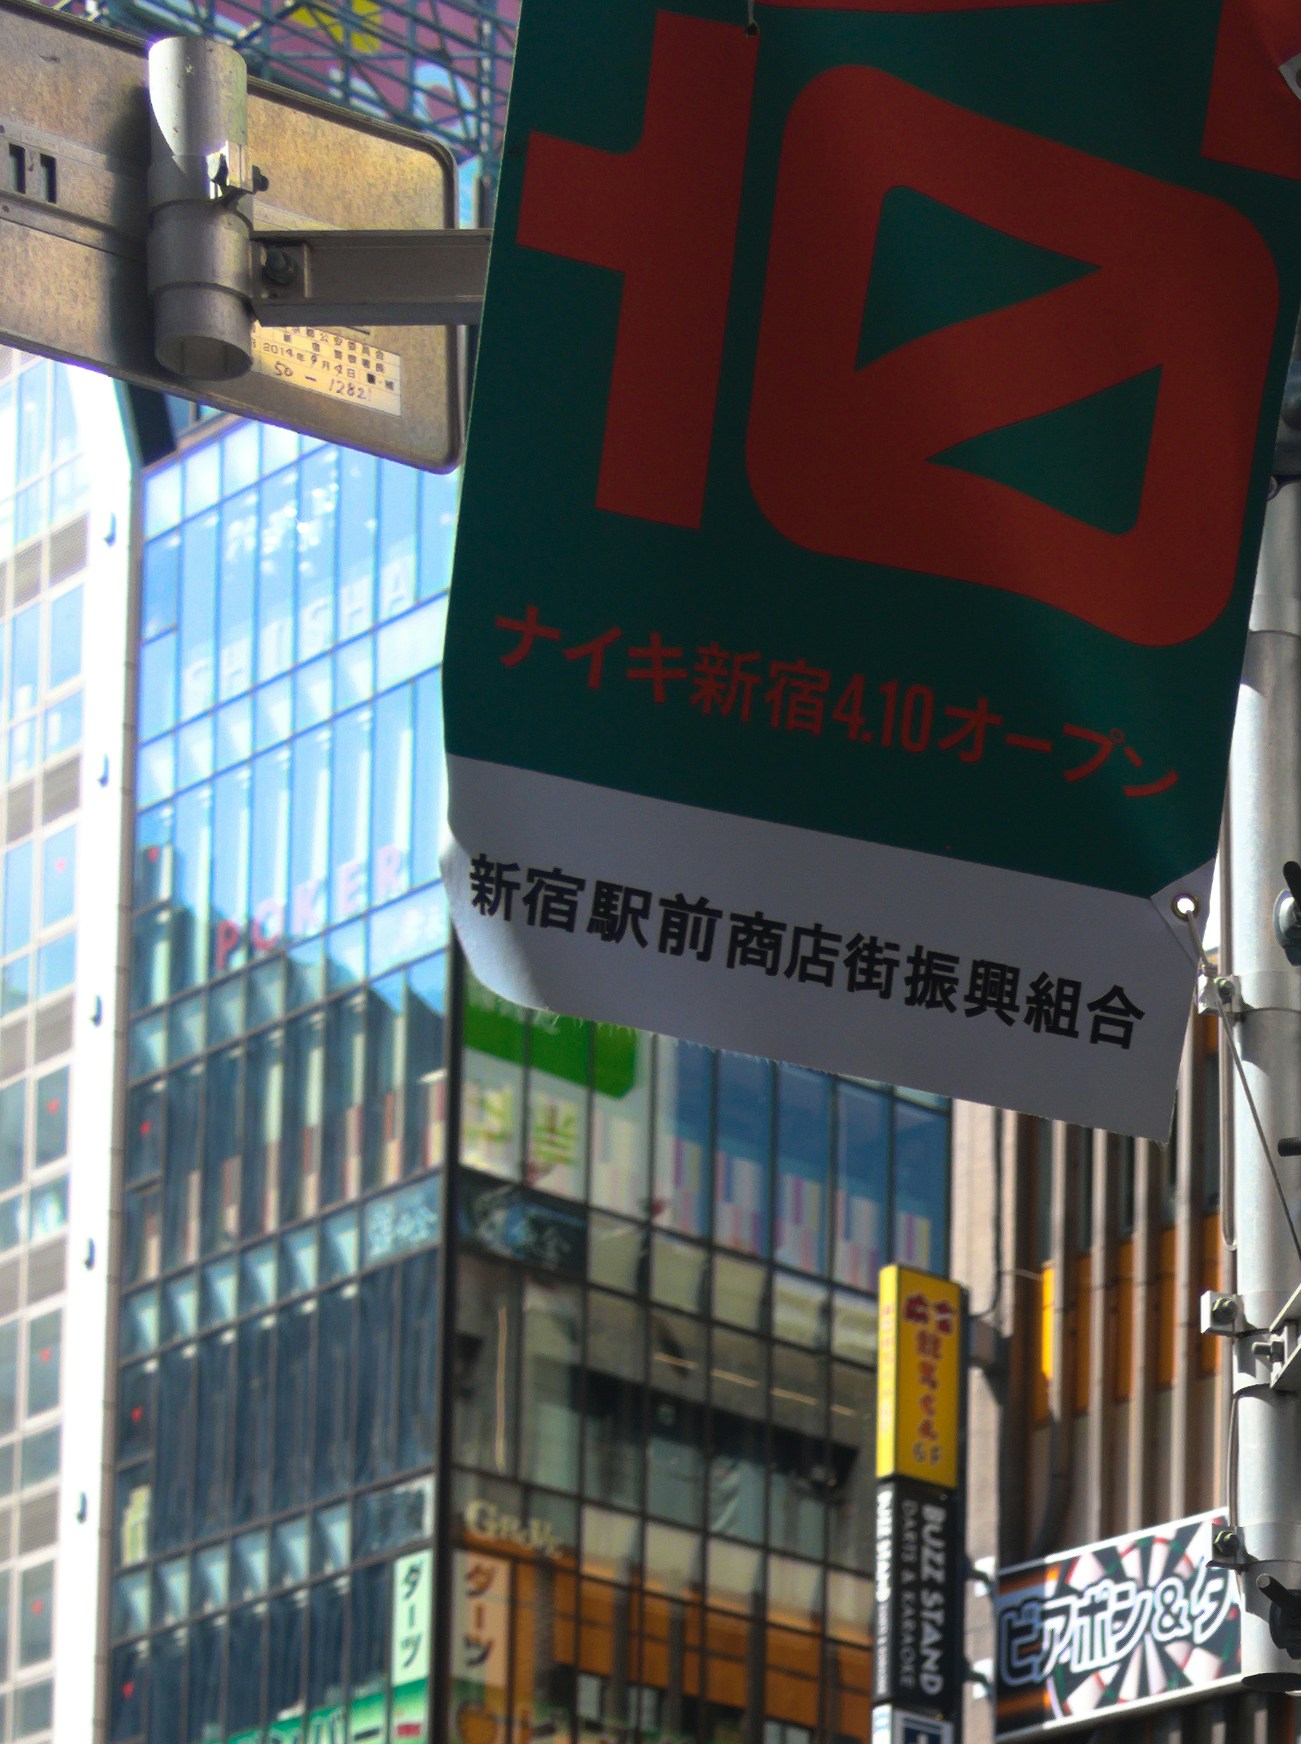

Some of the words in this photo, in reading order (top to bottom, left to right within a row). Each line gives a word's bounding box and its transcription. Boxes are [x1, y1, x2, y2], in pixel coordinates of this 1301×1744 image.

[494, 604, 1180, 801] ナイキ新宿4.10オープン
[214, 846, 405, 966] POKER
[467, 852, 1147, 1050] 新宿駅前商店街振興組合
[921, 1503, 946, 1583] BUZZ
[399, 1558, 425, 1668] ダーツ
[462, 1562, 498, 1669] ダーツ
[921, 1588, 946, 1696] STAND
